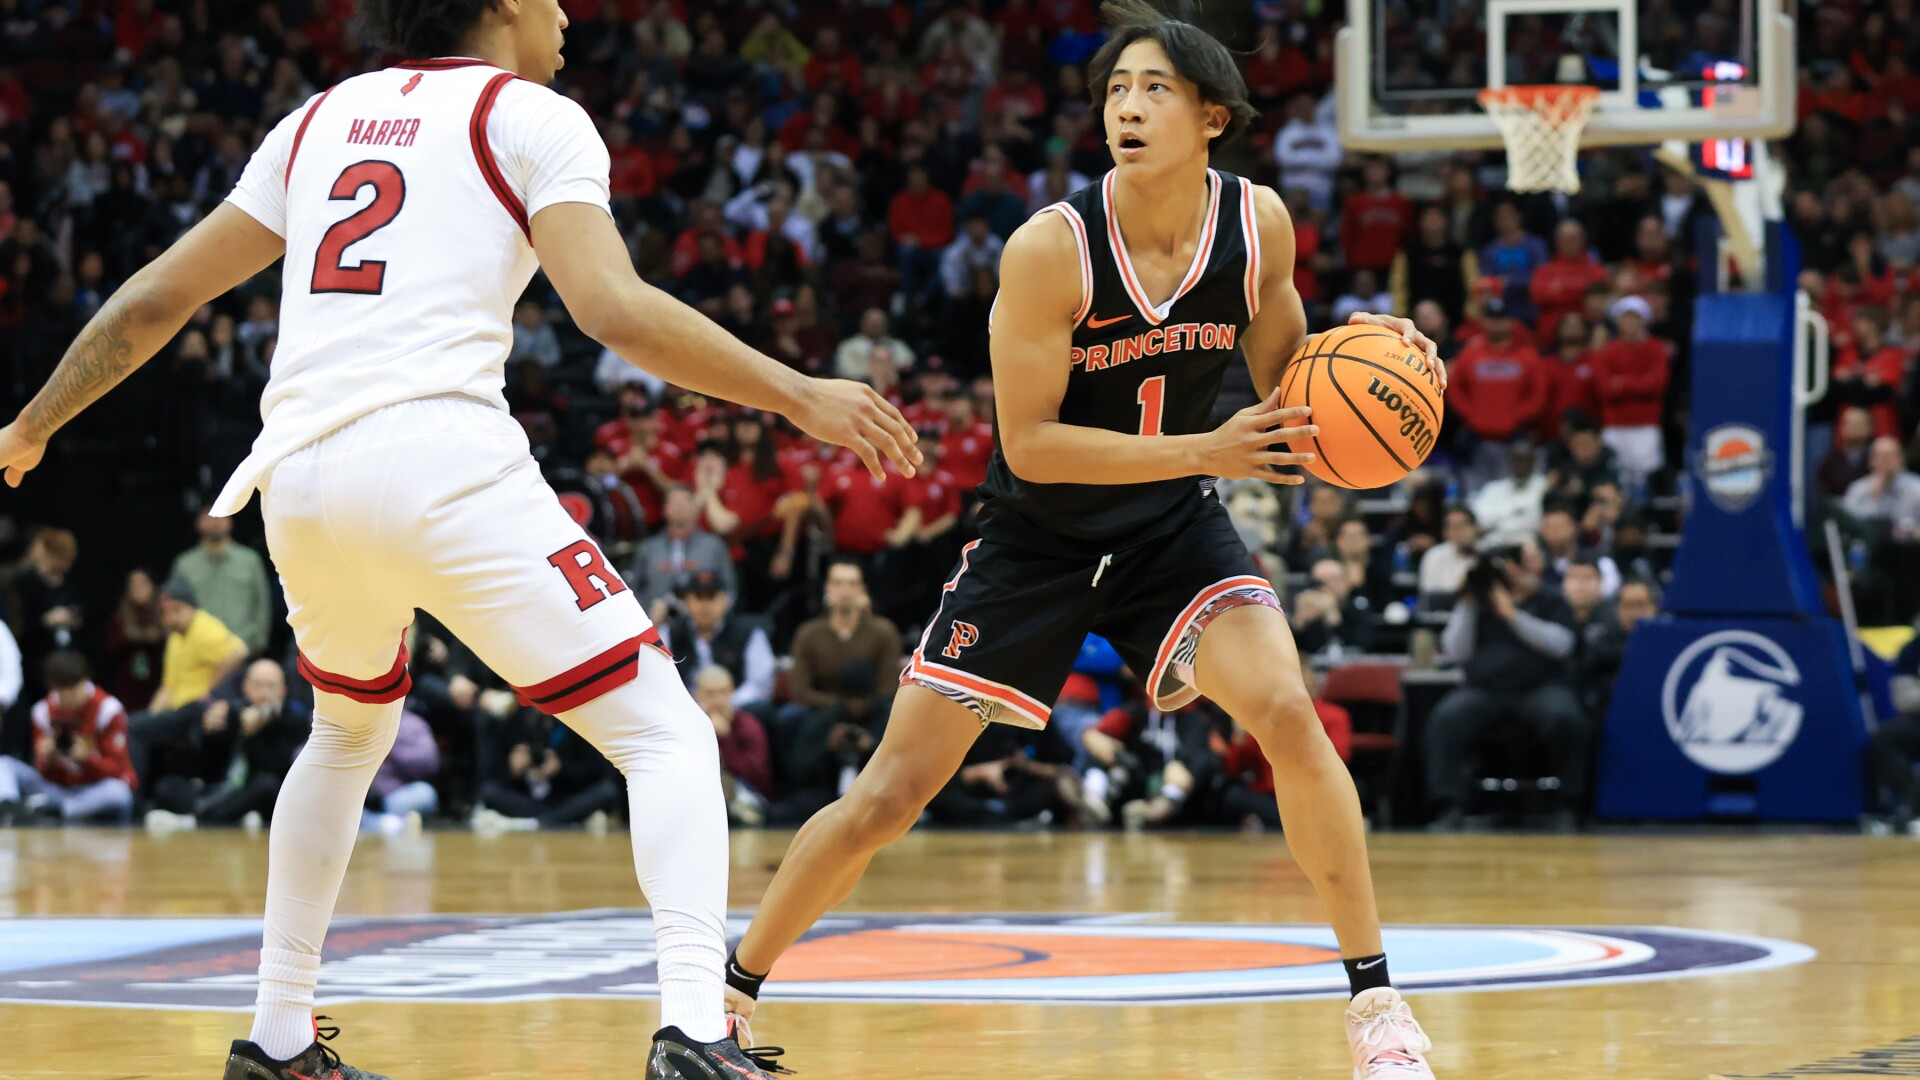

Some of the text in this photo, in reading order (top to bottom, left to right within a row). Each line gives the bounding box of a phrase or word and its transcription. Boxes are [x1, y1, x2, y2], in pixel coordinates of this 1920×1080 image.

[347, 118, 421, 147] HARPER
[310, 159, 406, 295] 2
[1070, 322, 1236, 373] PRINCETON
[1384, 351, 1404, 362] NXT
[1136, 375, 1166, 436] 1
[1367, 375, 1434, 460] Wilson
[546, 539, 627, 612] R
[942, 619, 979, 660] P
